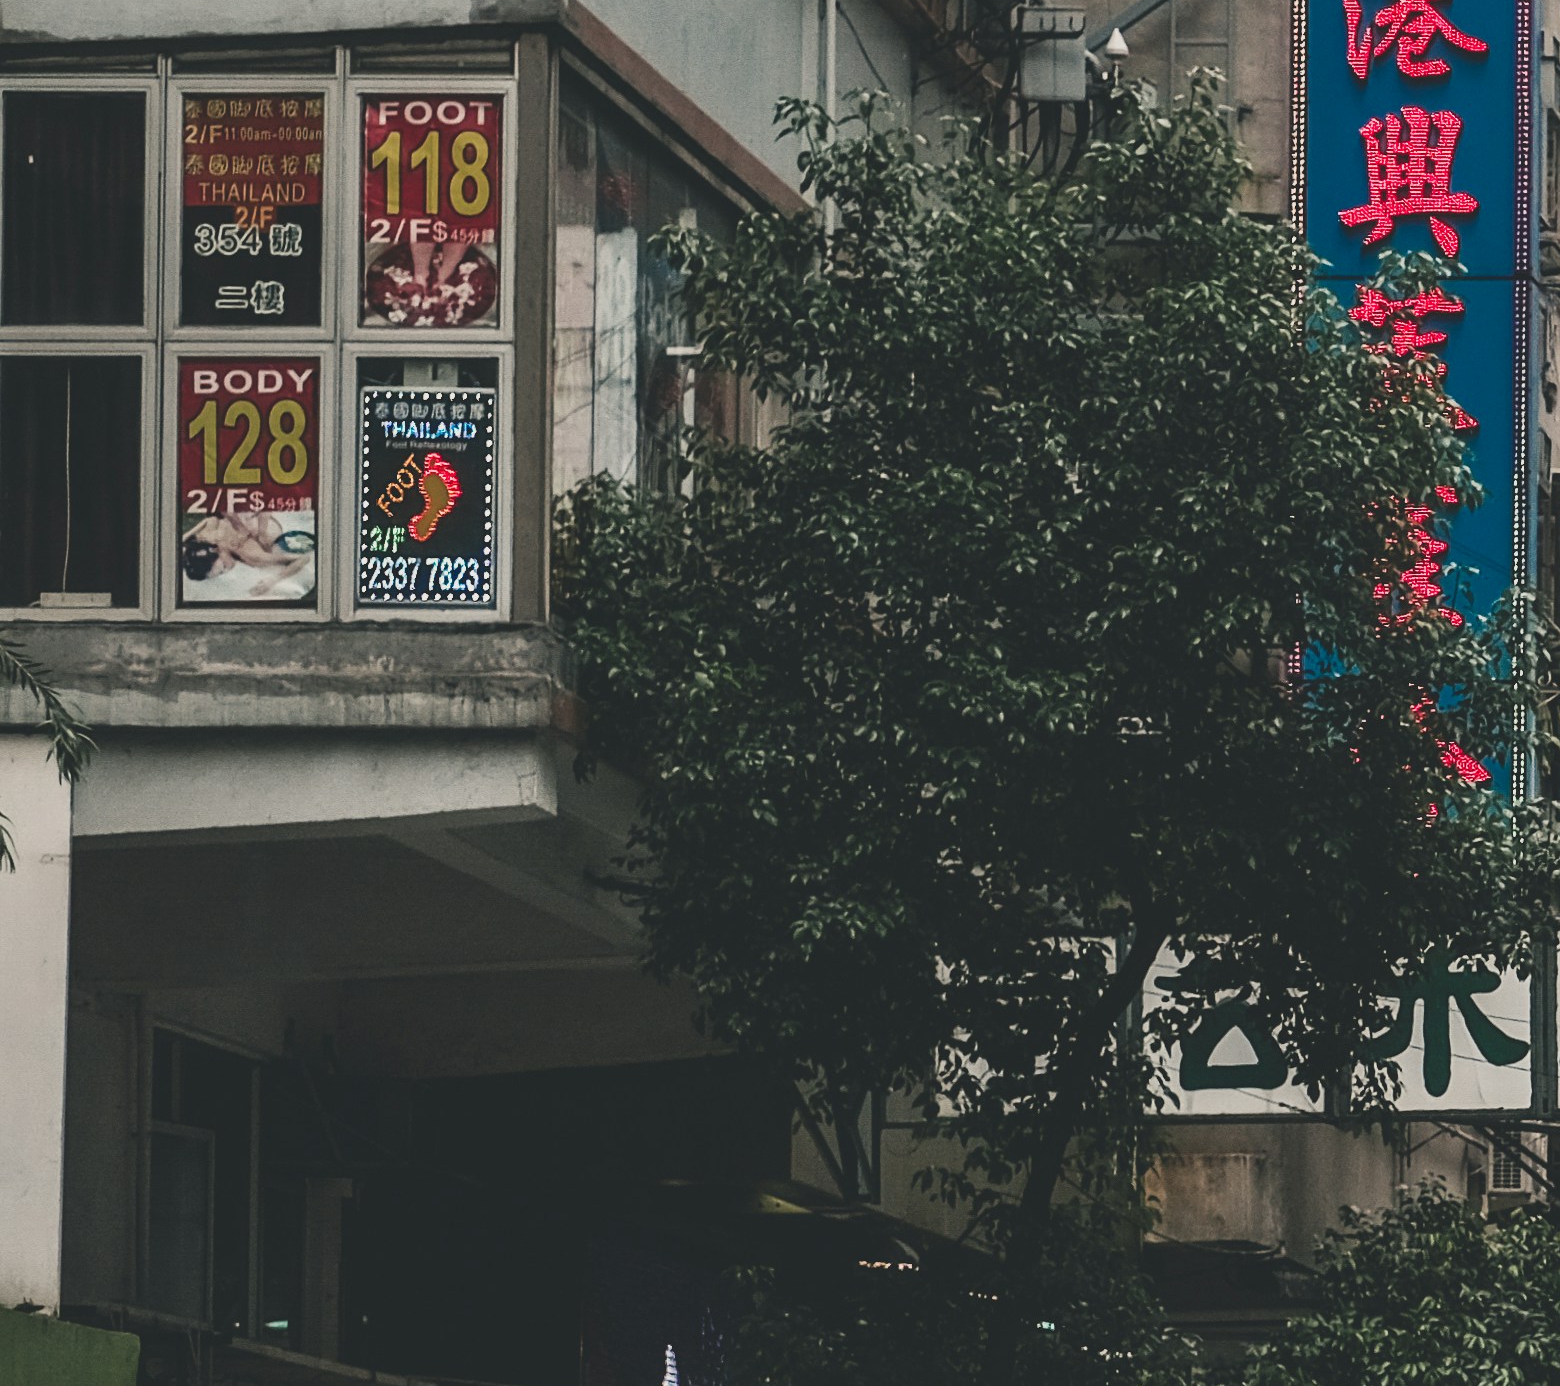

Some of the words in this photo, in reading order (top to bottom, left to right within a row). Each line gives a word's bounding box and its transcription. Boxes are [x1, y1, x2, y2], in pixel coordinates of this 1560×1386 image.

[378, 101, 493, 125] FOOT
[185, 125, 222, 144] 2/F
[372, 130, 490, 216] 118
[198, 182, 306, 203] THAILAND
[235, 206, 274, 229] 2/F
[194, 223, 263, 257] 354
[215, 280, 285, 315] 二樓
[193, 369, 313, 394] BODY
[188, 399, 308, 485] 128
[381, 420, 477, 440] THAILAND
[376, 453, 422, 517] FOOT
[370, 525, 406, 553] 2/F
[368, 556, 421, 591] 2337
[425, 556, 480, 591] 7823
